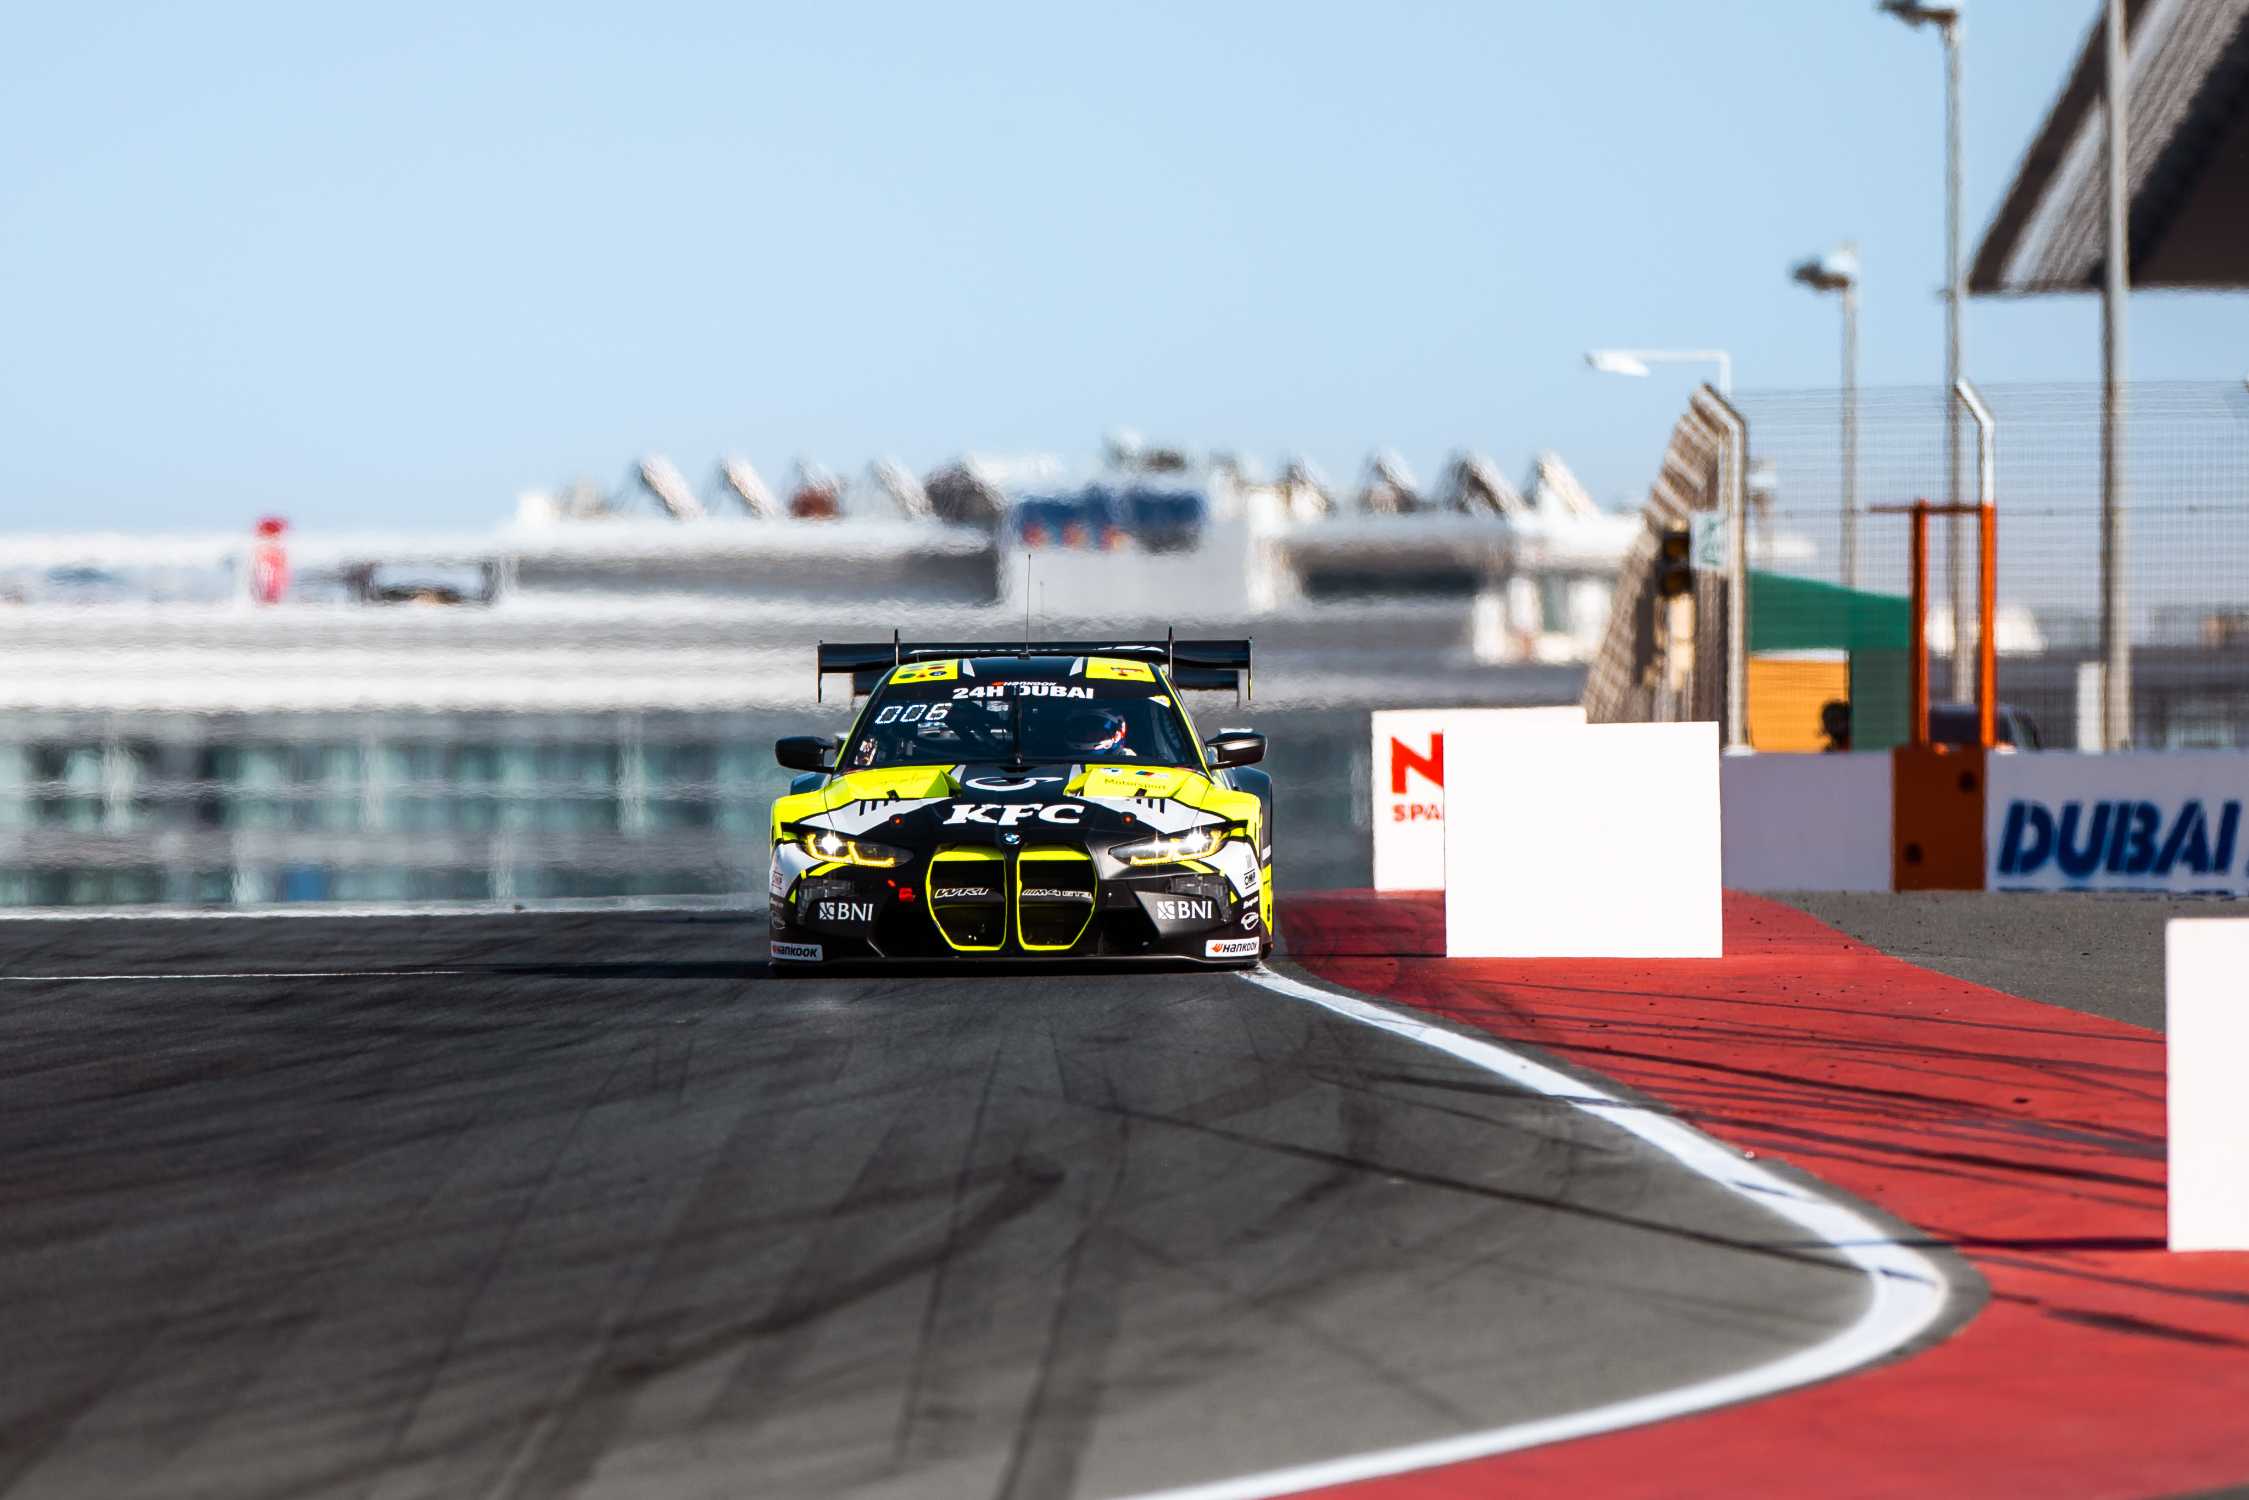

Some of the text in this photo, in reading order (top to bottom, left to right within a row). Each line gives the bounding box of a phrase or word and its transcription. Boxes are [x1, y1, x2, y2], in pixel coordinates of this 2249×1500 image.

[952, 685, 1095, 699] 24H DUBAI
[874, 702, 953, 725] 006
[1391, 732, 1444, 794] N
[942, 803, 1086, 826] KFC
[1996, 800, 2242, 879] DUBAI
[837, 902, 874, 921] BNI
[1177, 900, 1213, 919] BNI
